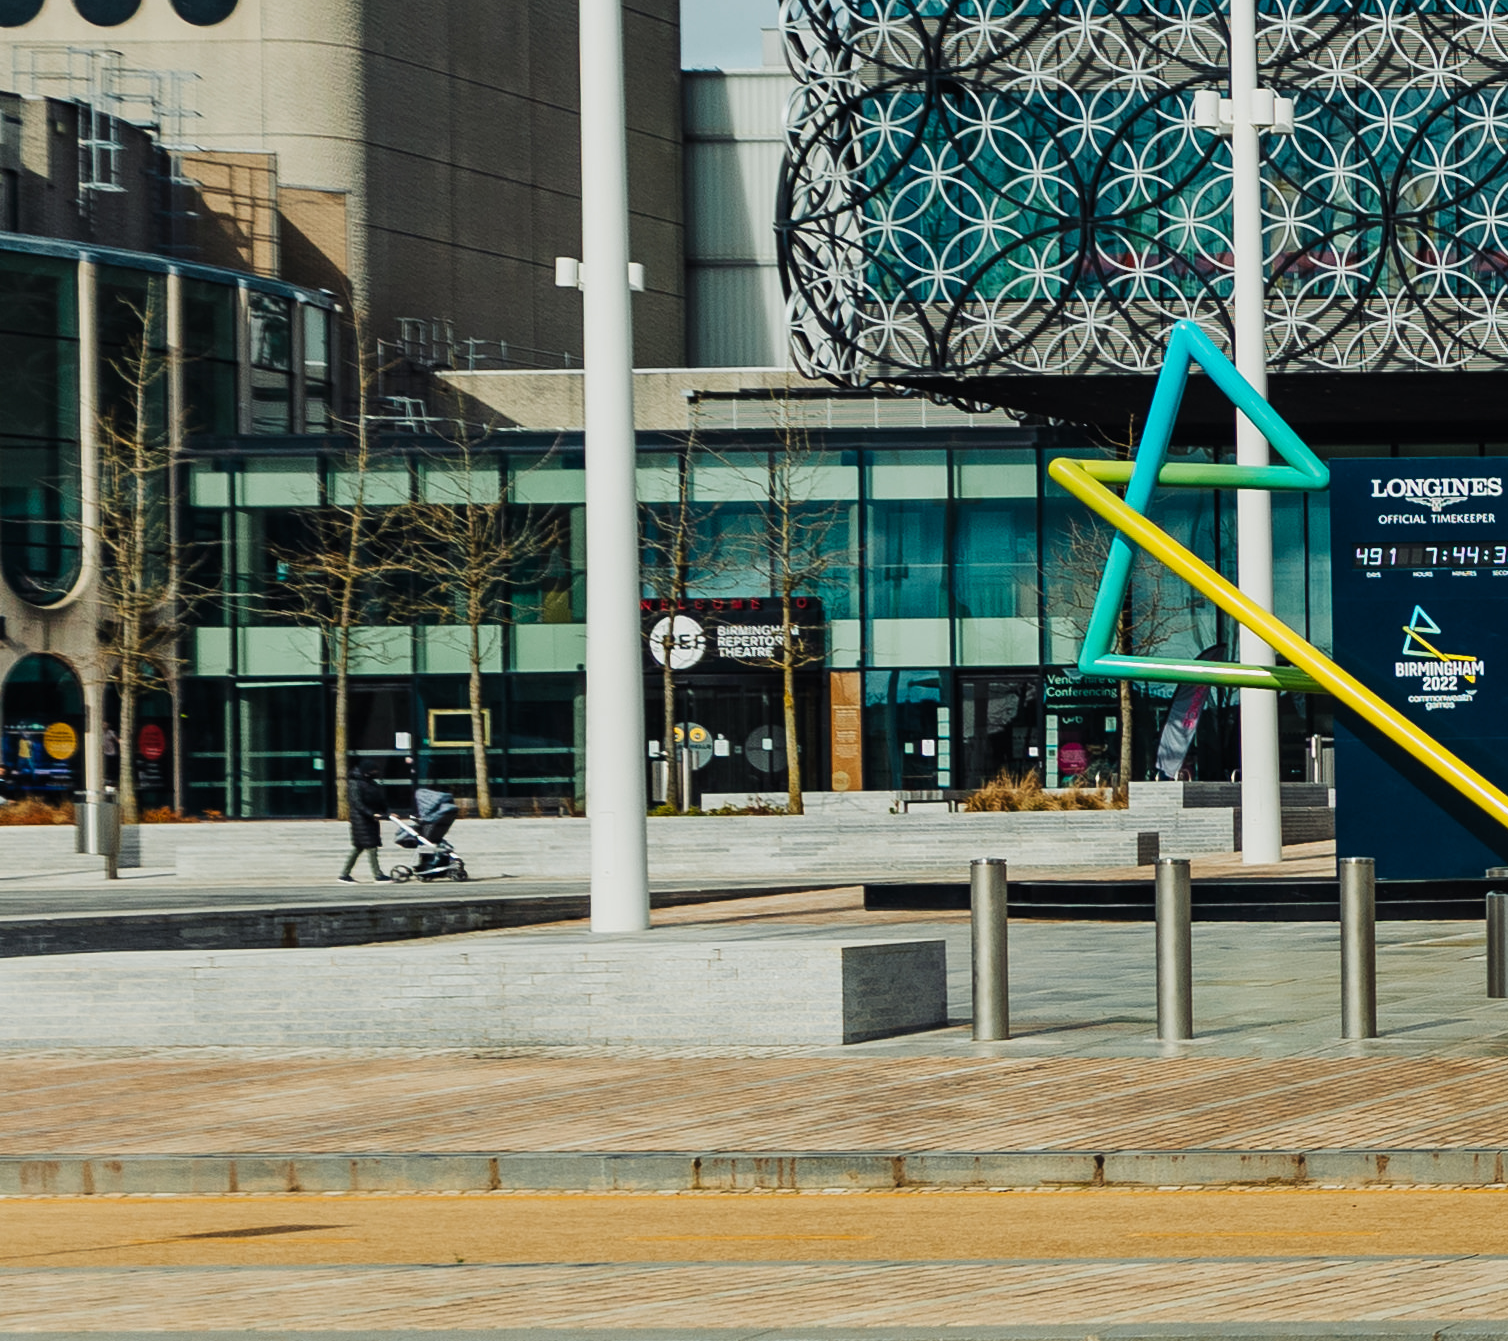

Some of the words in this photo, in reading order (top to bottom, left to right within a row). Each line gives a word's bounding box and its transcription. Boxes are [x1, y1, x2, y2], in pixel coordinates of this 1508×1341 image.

[1371, 478, 1503, 498] LONGINES
[1378, 515, 1427, 524] OFFICIAL
[1431, 514, 1495, 524] TIMEKEEPER
[1356, 547, 1397, 565] 491
[717, 636, 792, 647] REPERTOR
[718, 646, 774, 657] THEATRE
[1395, 661, 1484, 677] BIRMINGHAM
[1422, 677, 1458, 691] 2022
[1046, 687, 1118, 698] Conferencing
[1408, 694, 1473, 703] commonwealth
[1425, 702, 1455, 711] games
